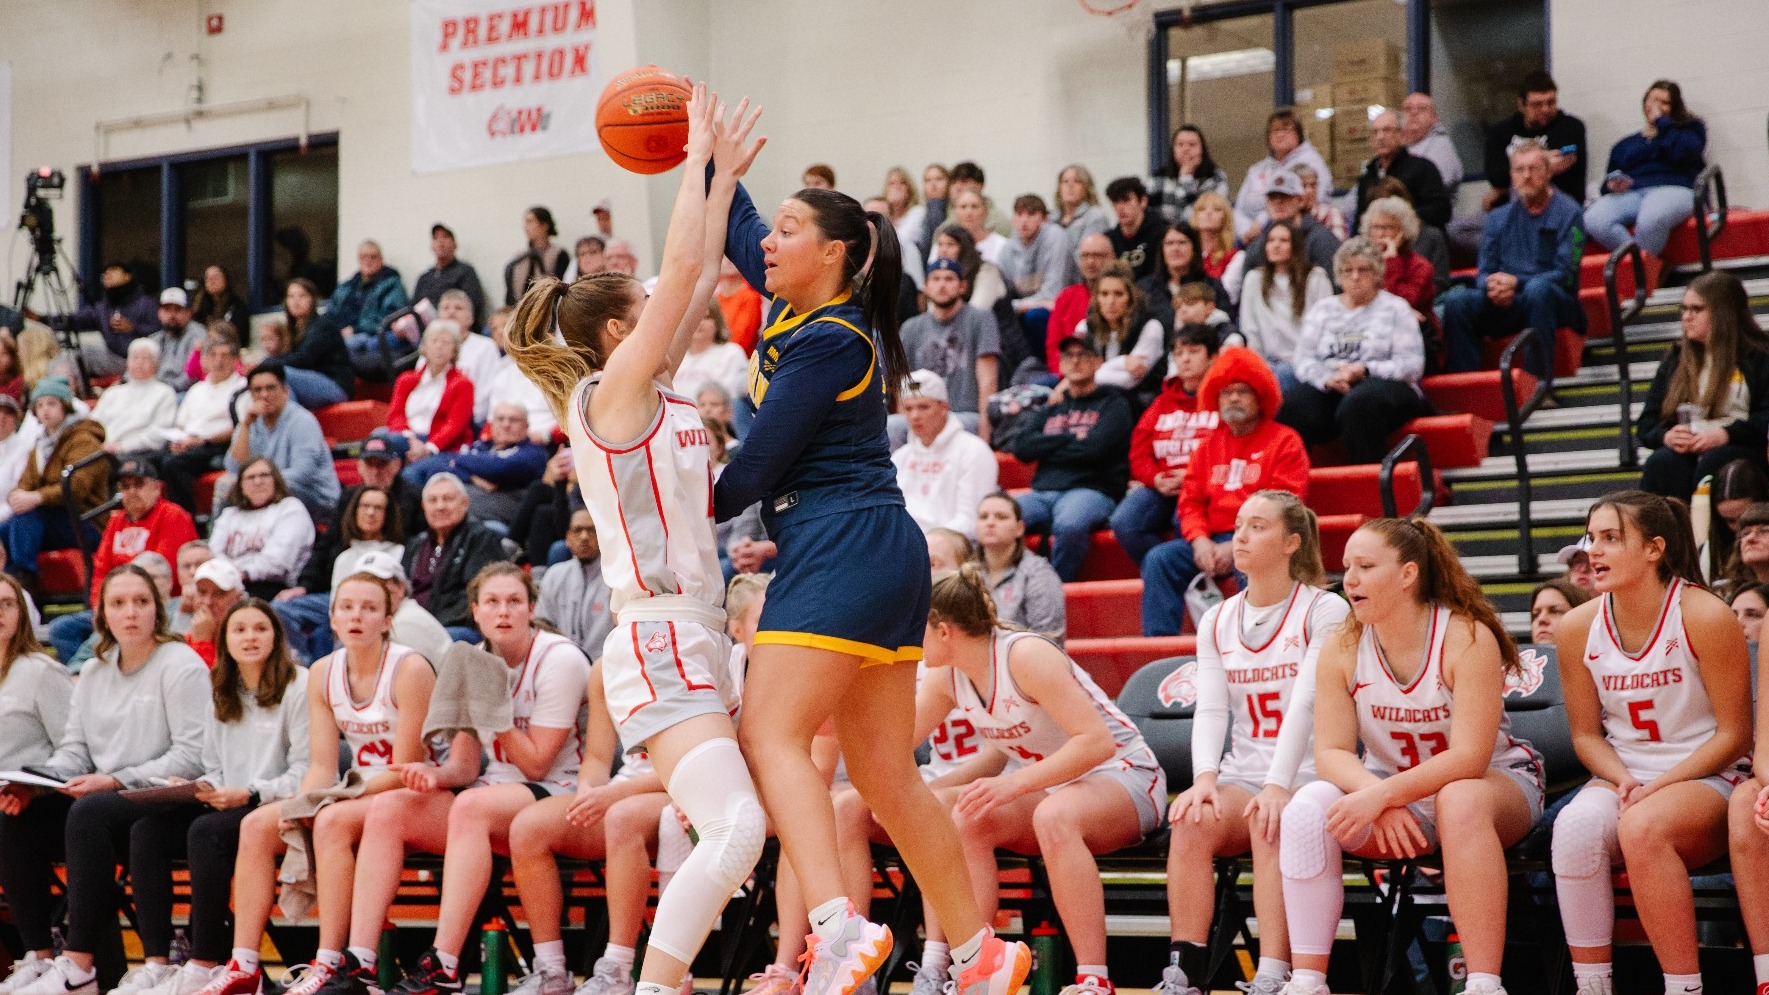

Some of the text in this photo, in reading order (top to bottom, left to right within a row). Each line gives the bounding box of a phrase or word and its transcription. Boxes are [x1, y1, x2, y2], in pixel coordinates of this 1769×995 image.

[439, 0, 597, 53] PREMIUM
[448, 43, 592, 95] SECTION
[1225, 662, 1299, 685] WILDCATS
[1246, 691, 1283, 738] 15
[1371, 702, 1451, 724] WILDCATS
[1627, 698, 1662, 742] 5
